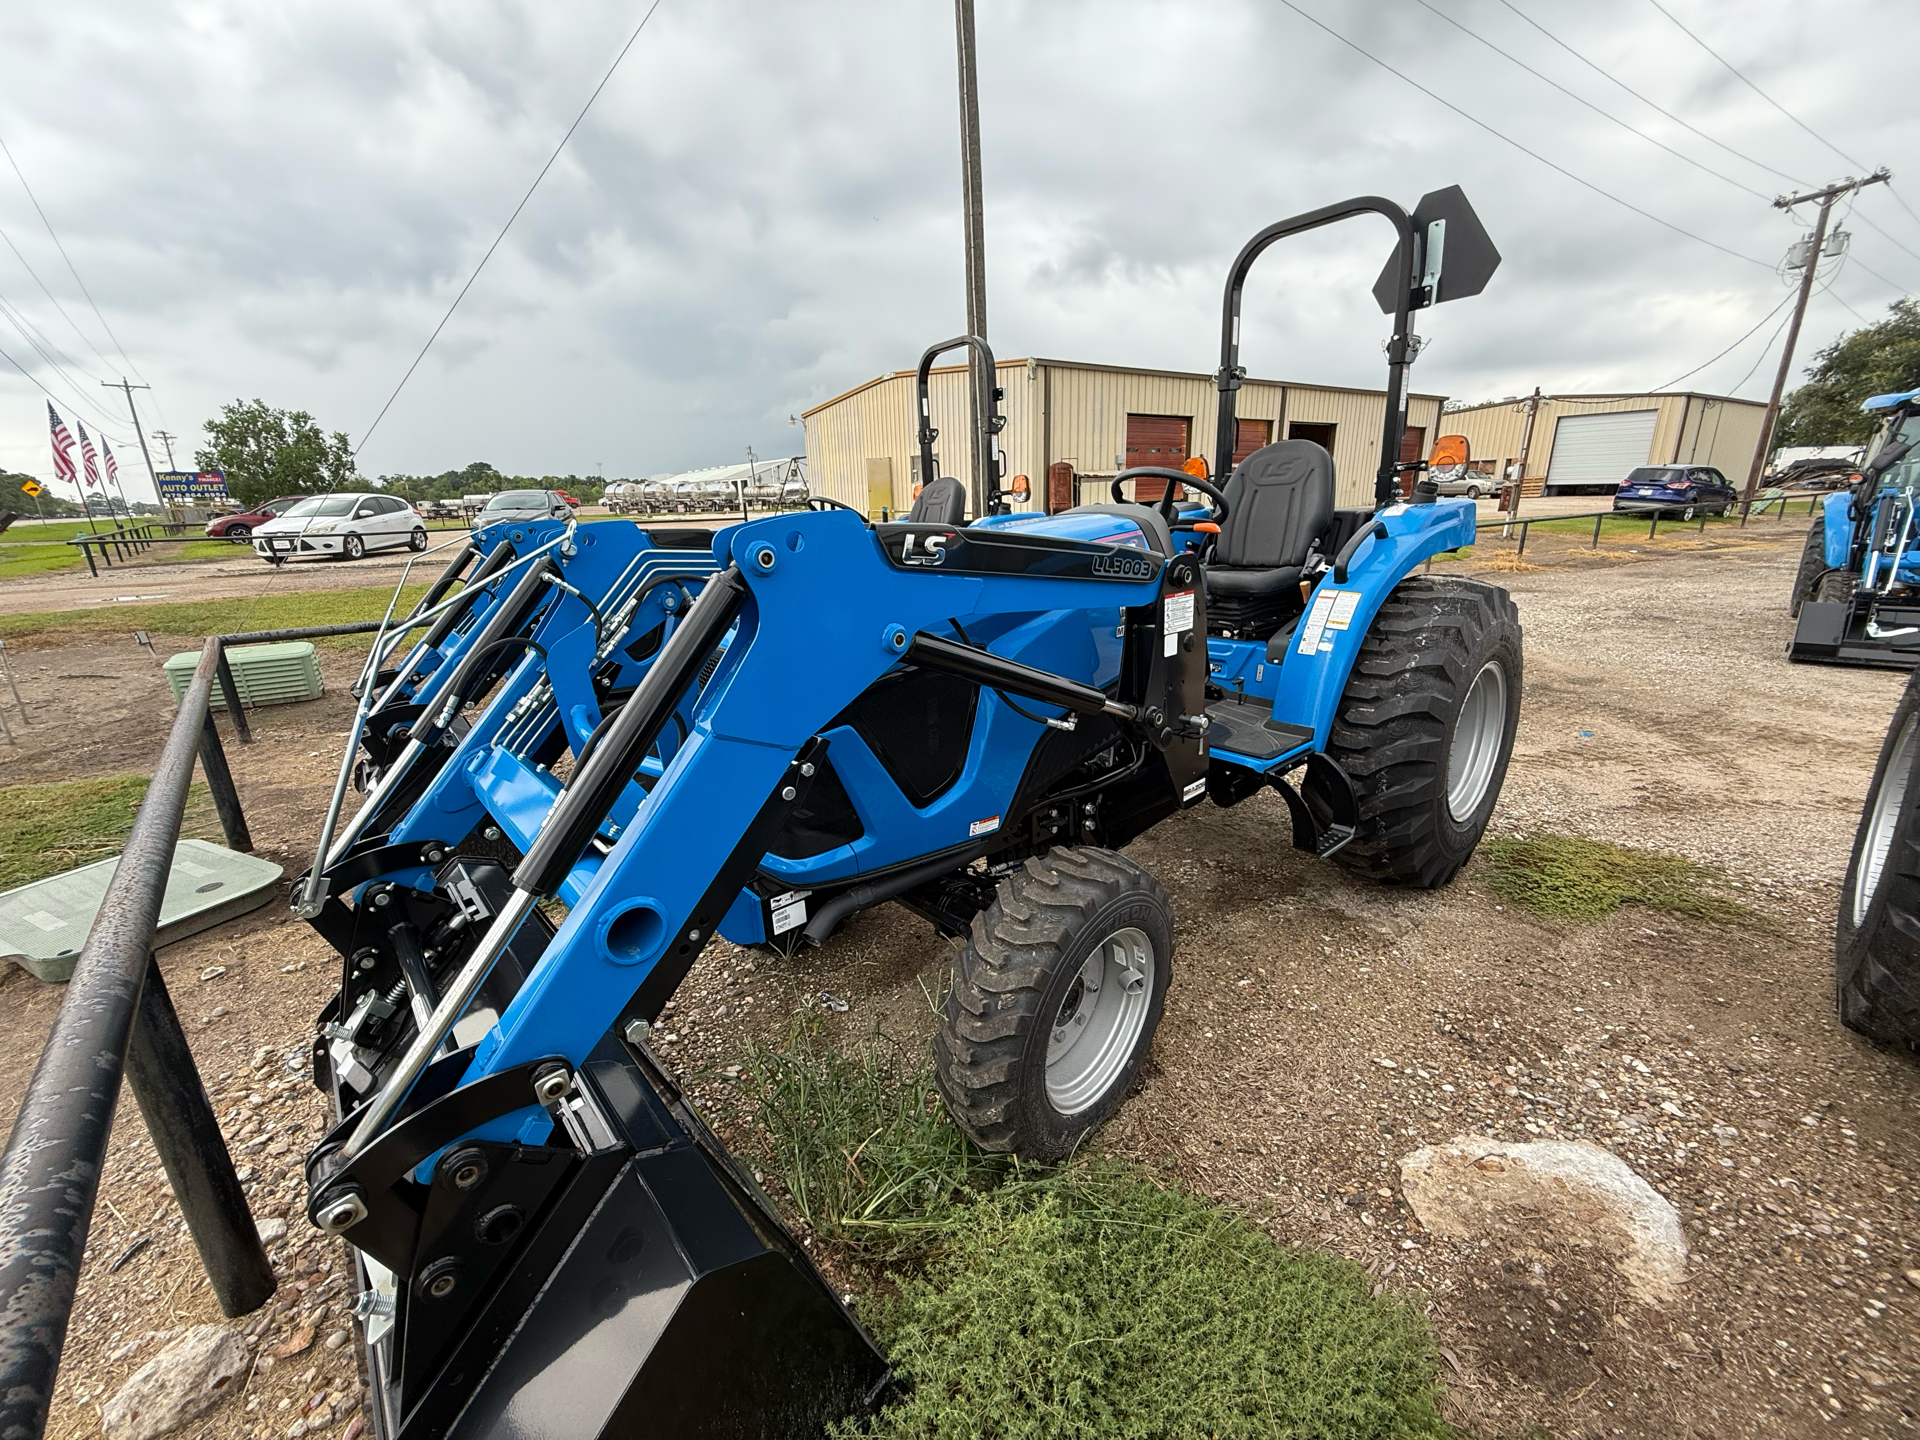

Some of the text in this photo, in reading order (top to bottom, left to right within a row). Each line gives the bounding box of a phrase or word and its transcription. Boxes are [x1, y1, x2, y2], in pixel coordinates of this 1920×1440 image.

[159, 474, 193, 482] Kenny's
[1260, 461, 1294, 480] LS
[903, 534, 947, 565] LS
[1092, 556, 1151, 579] LL3003
